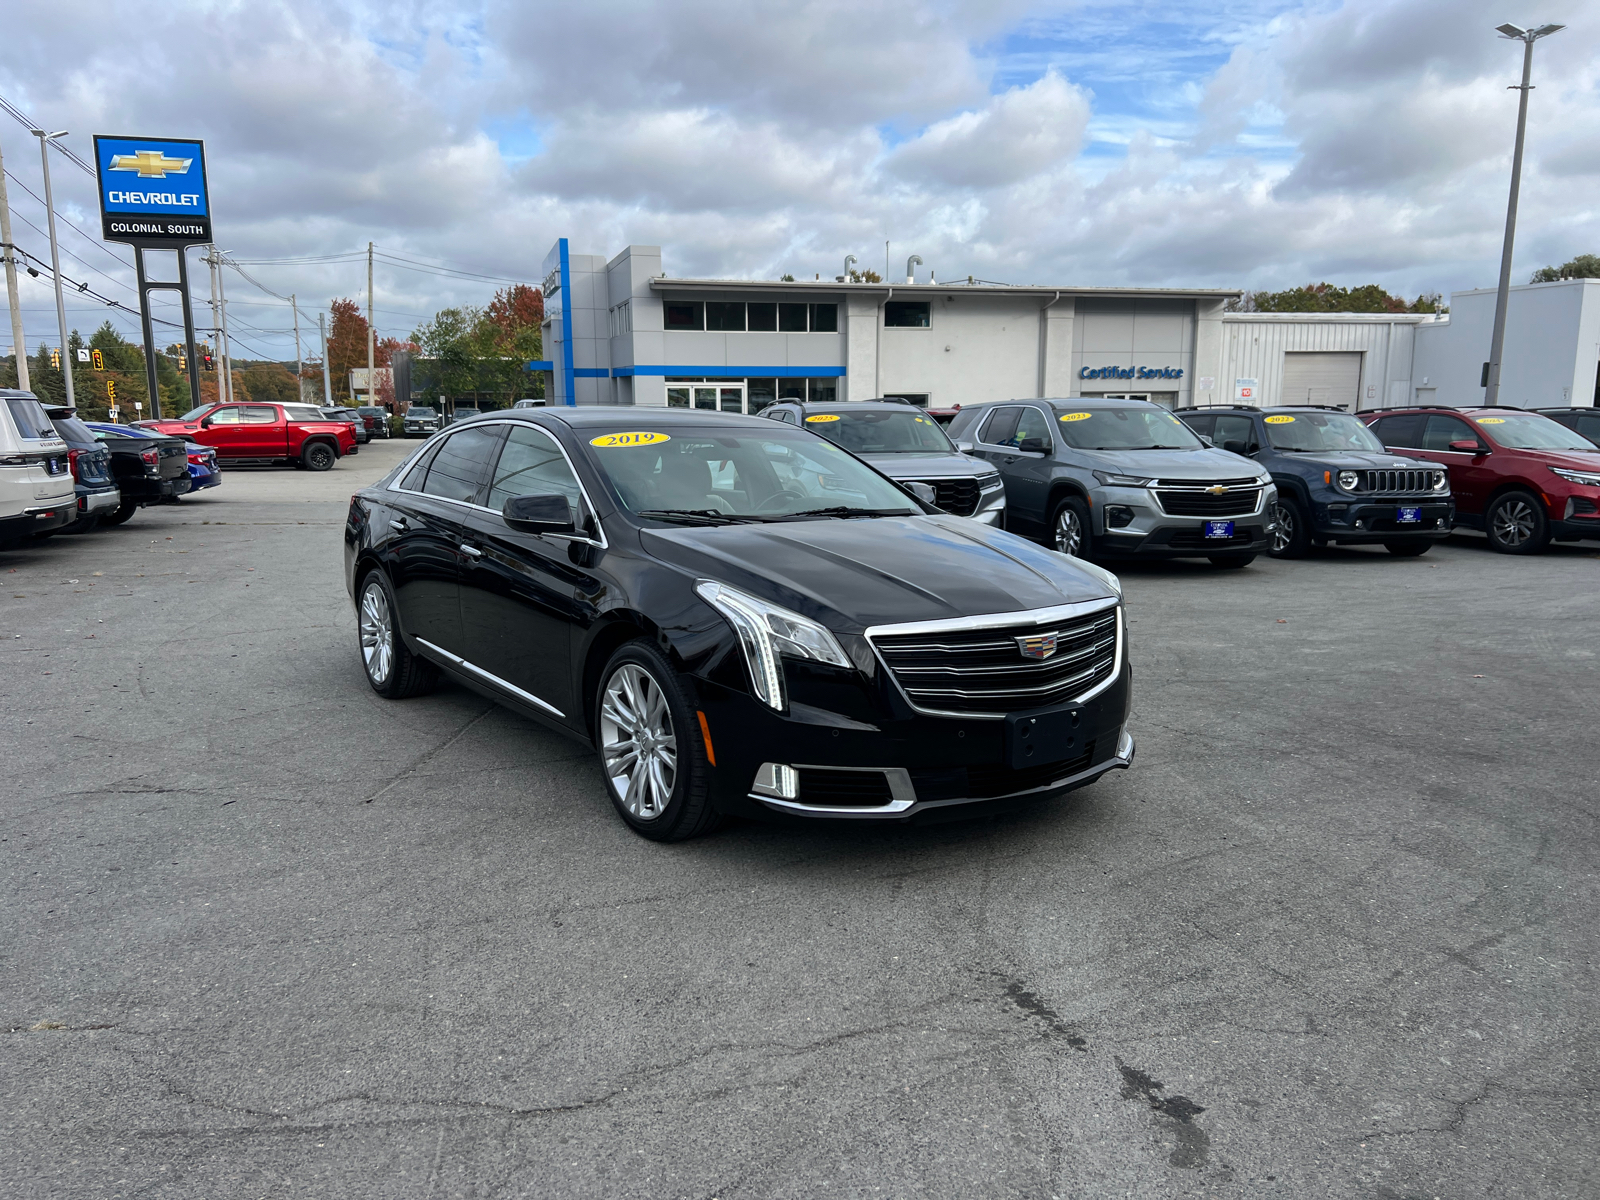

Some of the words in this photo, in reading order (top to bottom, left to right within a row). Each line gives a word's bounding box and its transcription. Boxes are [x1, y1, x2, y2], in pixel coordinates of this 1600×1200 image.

[109, 191, 199, 206] CHEVROLET
[111, 223, 164, 233] COLONIAL
[168, 225, 203, 234] SOUTH
[1081, 366, 1136, 379] Certified
[1140, 366, 1184, 379] Service
[1066, 413, 1088, 421] 2023
[606, 433, 655, 446] 2019
